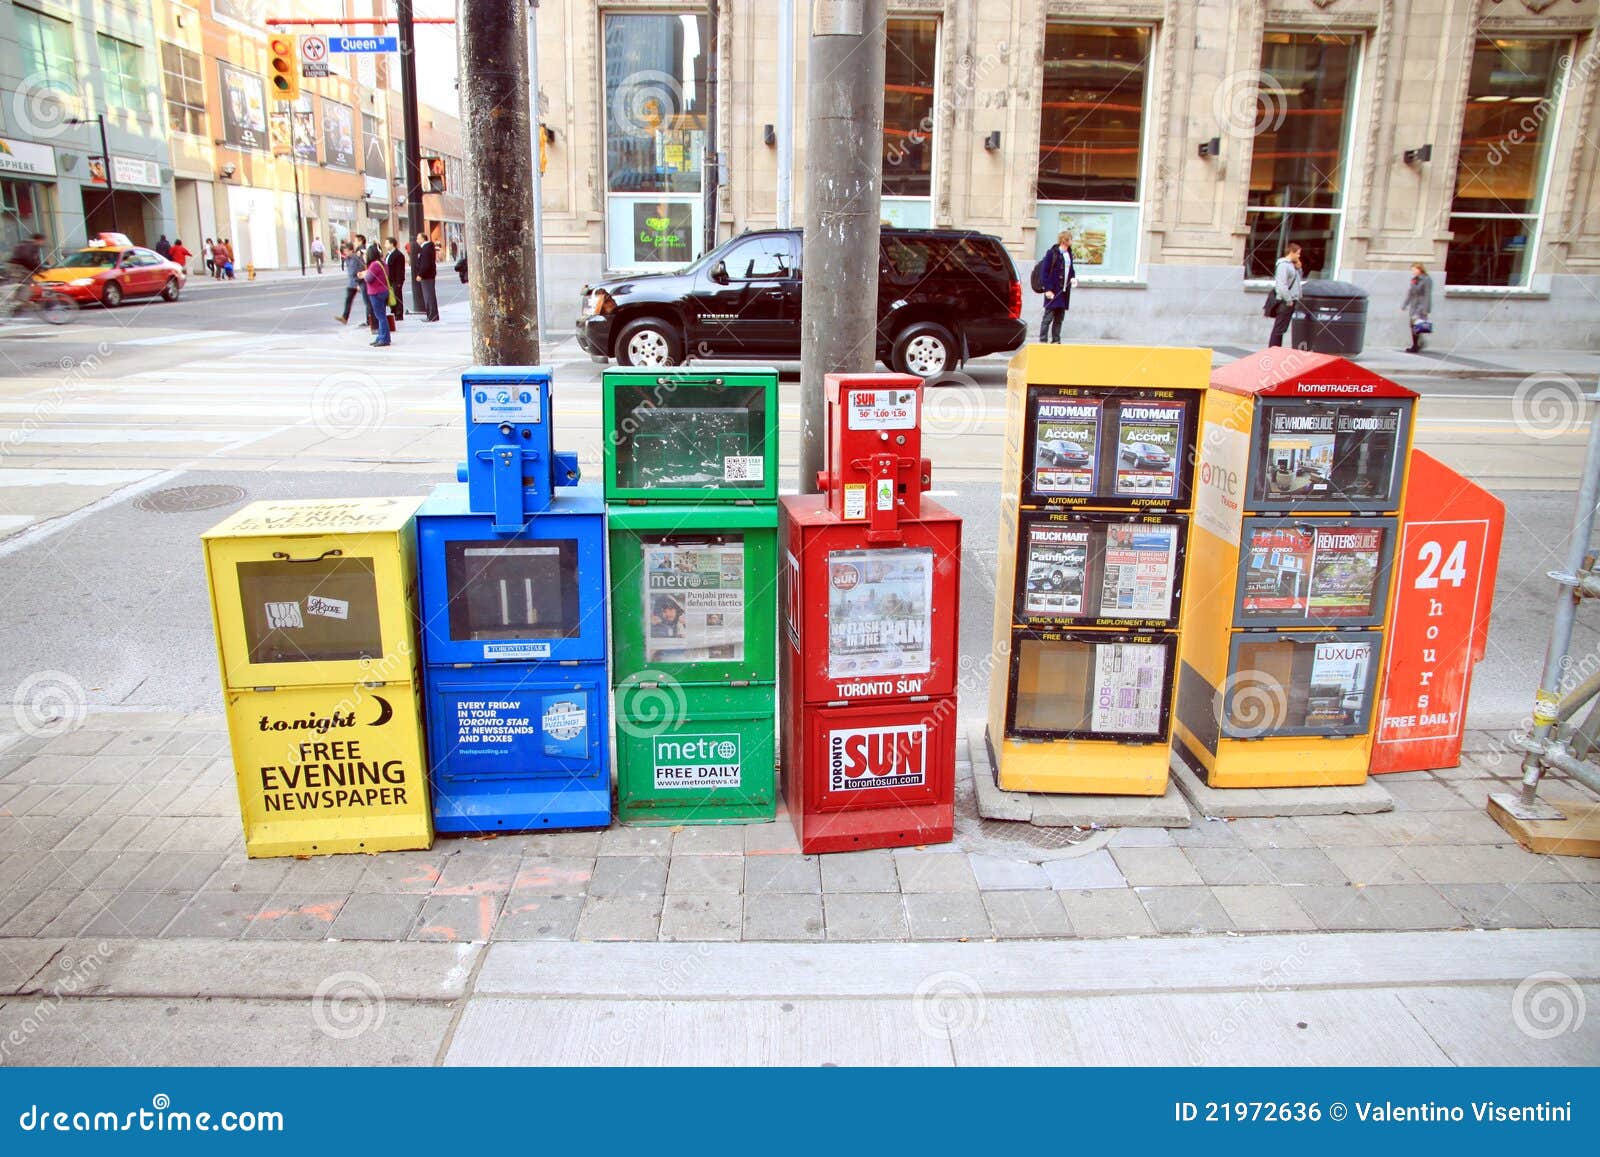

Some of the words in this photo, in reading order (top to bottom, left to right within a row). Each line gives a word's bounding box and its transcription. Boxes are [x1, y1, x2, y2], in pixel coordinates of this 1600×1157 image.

[340, 38, 377, 51] Queen
[0, 159, 35, 172] SPHERE
[856, 393, 875, 406] SUN
[1044, 429, 1088, 440] Accord
[1126, 431, 1170, 442] Accord
[1199, 462, 1237, 495] ome
[1048, 497, 1088, 505] AUTOMART
[1031, 551, 1085, 562] Pathfinder
[1414, 540, 1467, 589] 24
[651, 574, 701, 588] metro
[833, 573, 857, 584] SUN
[687, 591, 717, 601] Punjabi
[718, 593, 738, 602] press
[1096, 618, 1143, 626] EMPLOYMENT
[1145, 619, 1167, 627] NEWS
[880, 619, 924, 644] PAN
[1317, 647, 1371, 661] LUXURY
[836, 682, 893, 697] TORONTO
[896, 679, 921, 693] SUN
[457, 701, 485, 710] EVERY
[488, 701, 521, 709] FRIDAY
[457, 710, 469, 718] IN
[471, 710, 497, 718] YOUR
[1382, 715, 1417, 729] FREE
[1419, 711, 1459, 727] DAILY
[258, 711, 357, 734] t.o.night
[458, 718, 504, 726] TORONTO
[506, 718, 529, 726] STAR
[458, 726, 470, 735] AT
[472, 726, 534, 735] NEWSSTANDS
[458, 735, 480, 743] AND
[482, 734, 513, 743] BOXES
[299, 740, 362, 762] FREE
[657, 737, 737, 760] metro
[844, 730, 923, 779] SUN
[832, 736, 843, 790] TORONTO
[260, 759, 406, 791] EVENING
[656, 767, 693, 779] FREE
[698, 766, 740, 778] DAILY
[657, 778, 739, 787] www.metronews.ca
[847, 775, 920, 789] torontosun.com
[263, 787, 408, 812] NEWSPAPER
